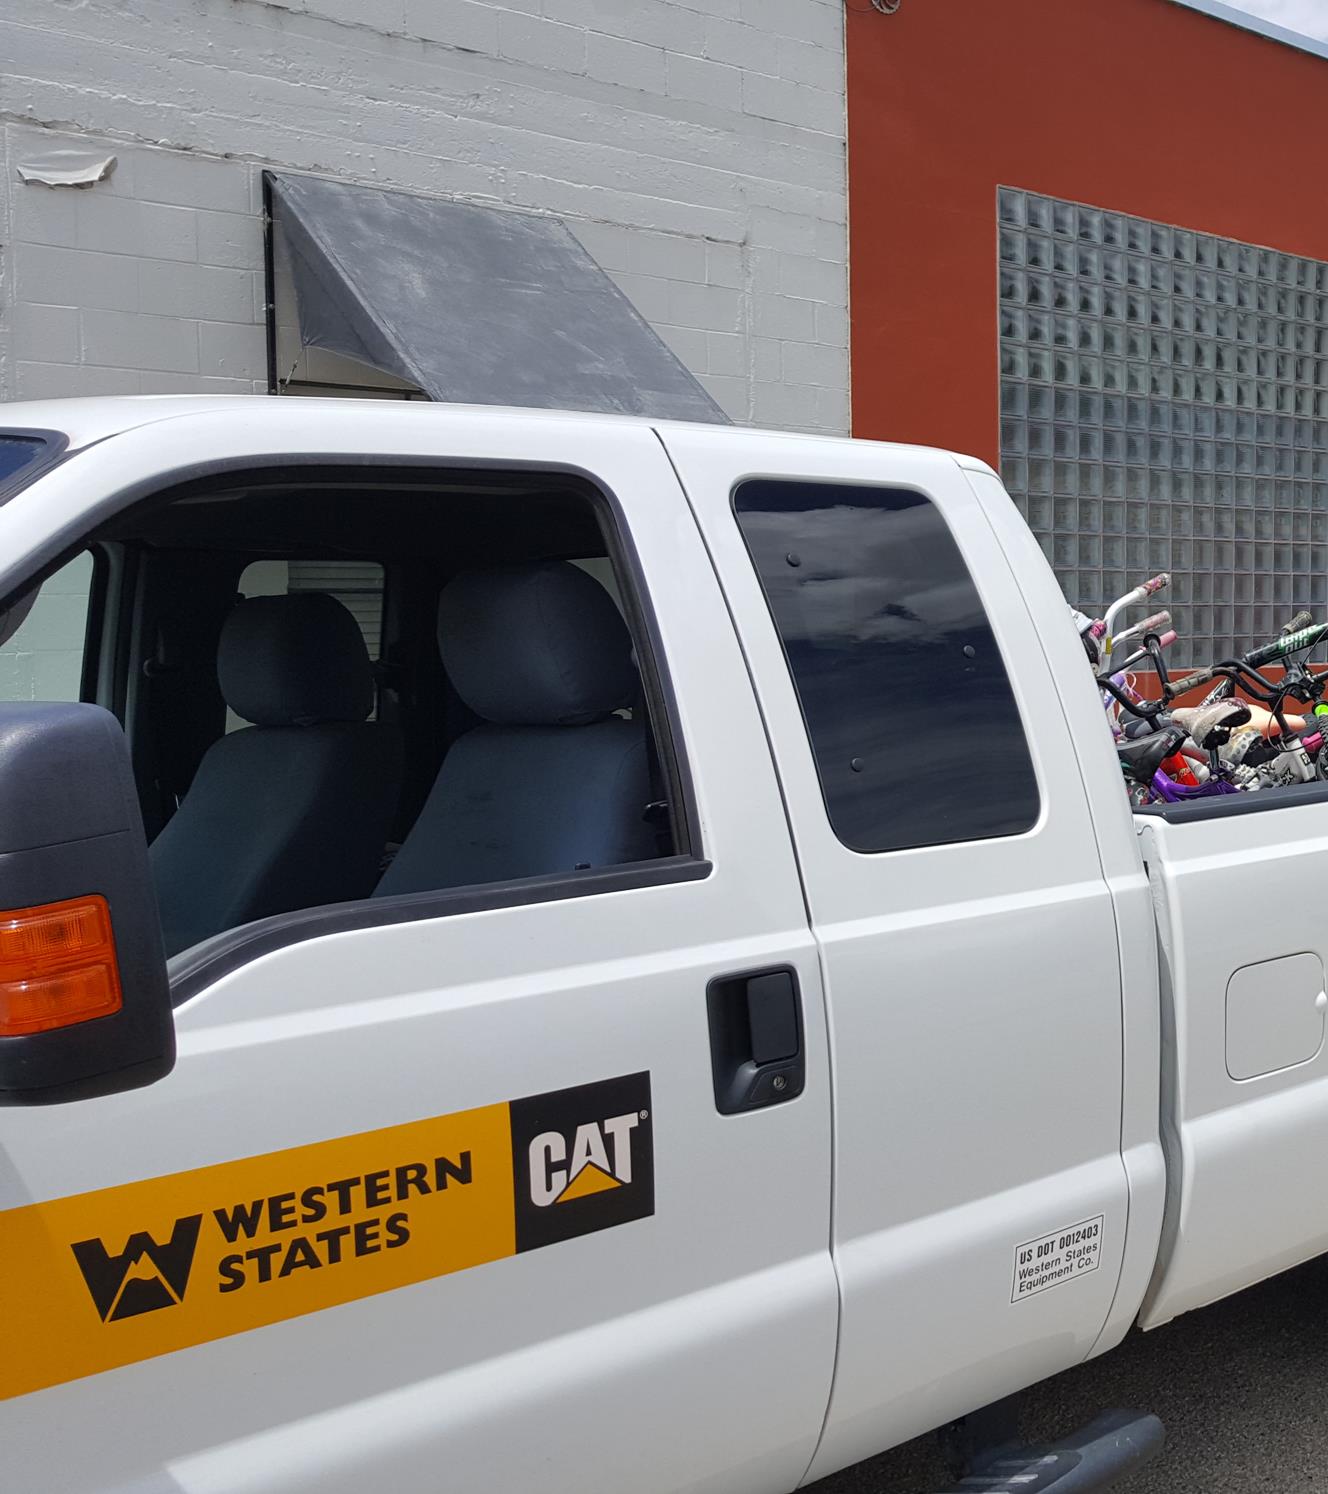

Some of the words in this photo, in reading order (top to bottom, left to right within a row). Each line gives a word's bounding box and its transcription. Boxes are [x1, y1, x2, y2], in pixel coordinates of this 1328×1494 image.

[528, 1111, 639, 1208] CAT
[213, 1150, 472, 1243] WESTERN
[219, 1212, 410, 1293] STATES
[1018, 1257, 1061, 1281] Western
[1065, 1243, 1098, 1262] States
[1019, 1262, 1073, 1293] Equipment
[1077, 1257, 1094, 1269] Co.
[1020, 1248, 1033, 1265] US
[1037, 1240, 1056, 1258] DOT
[1059, 1224, 1099, 1250] 0012403
